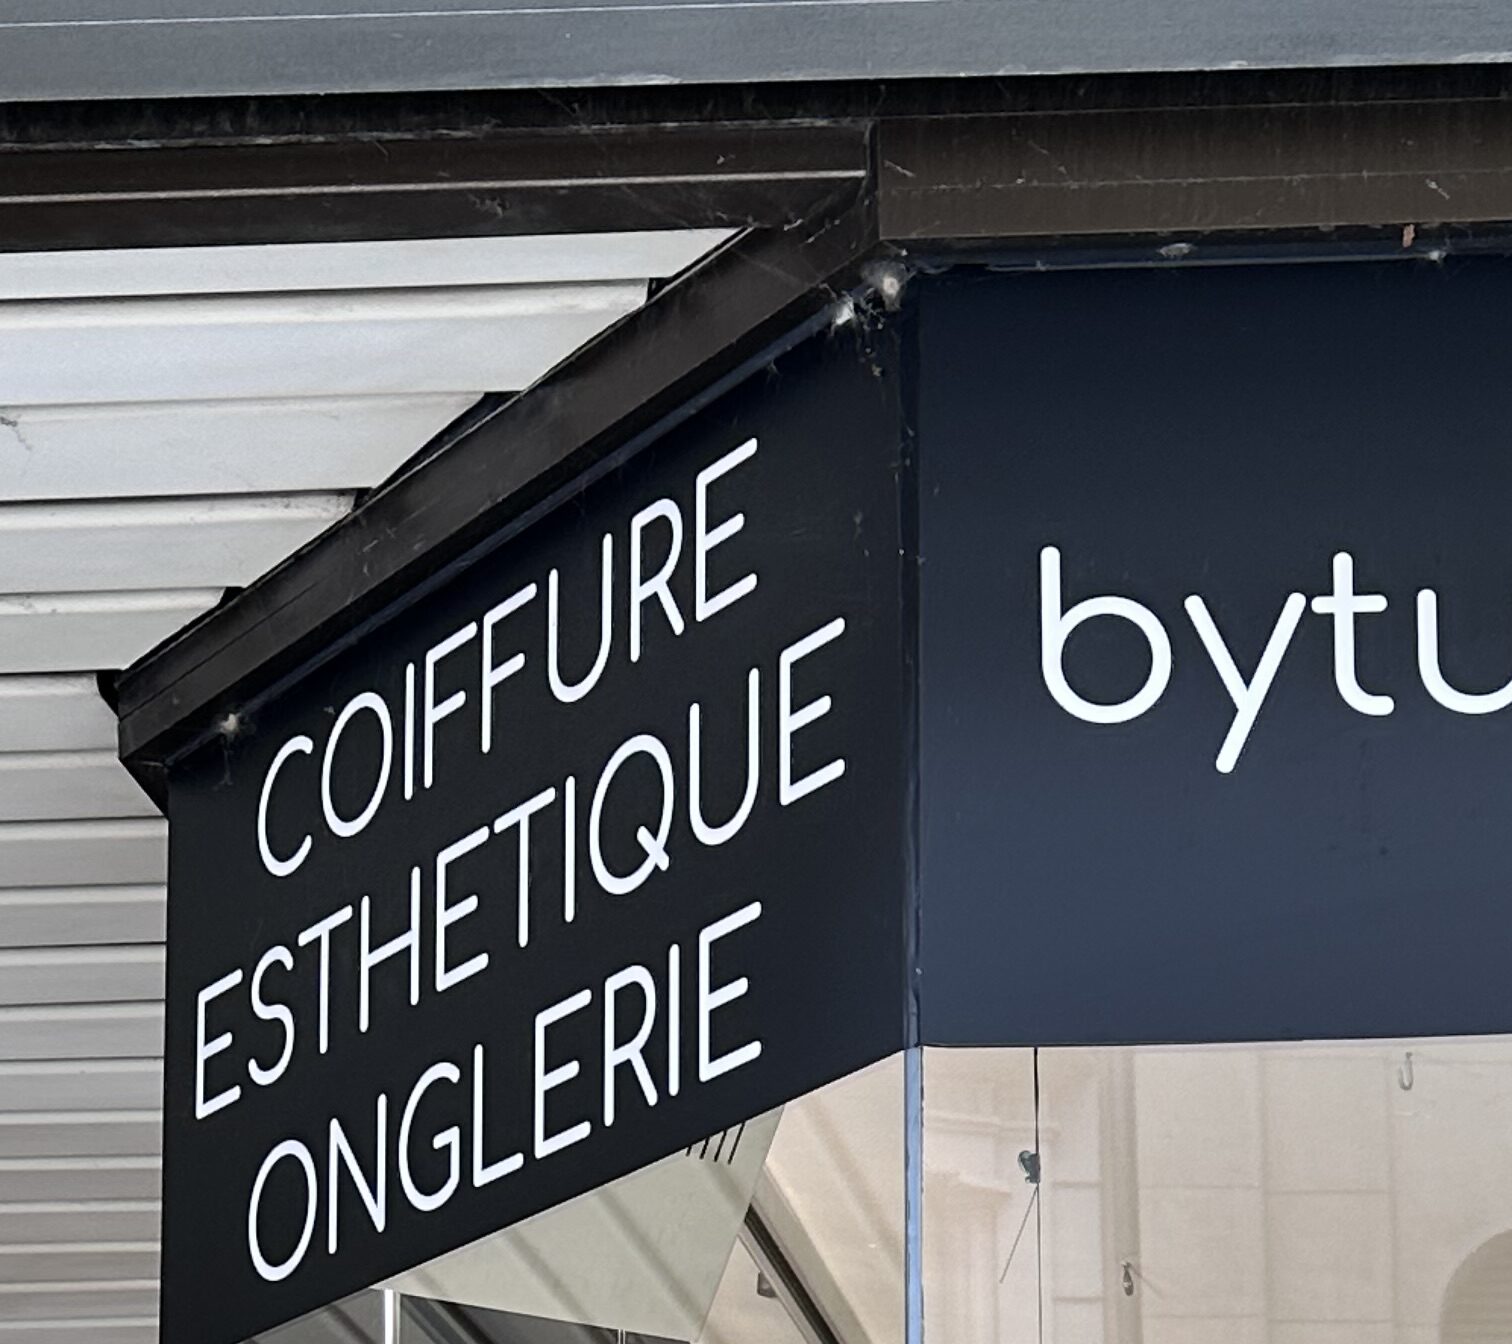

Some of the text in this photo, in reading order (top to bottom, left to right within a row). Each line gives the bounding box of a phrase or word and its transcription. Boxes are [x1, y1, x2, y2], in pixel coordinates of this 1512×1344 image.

[195, 617, 846, 1120] ESTHETIQUE
[256, 436, 759, 878] COIFFURE
[248, 901, 763, 1282] ONGLERIE
